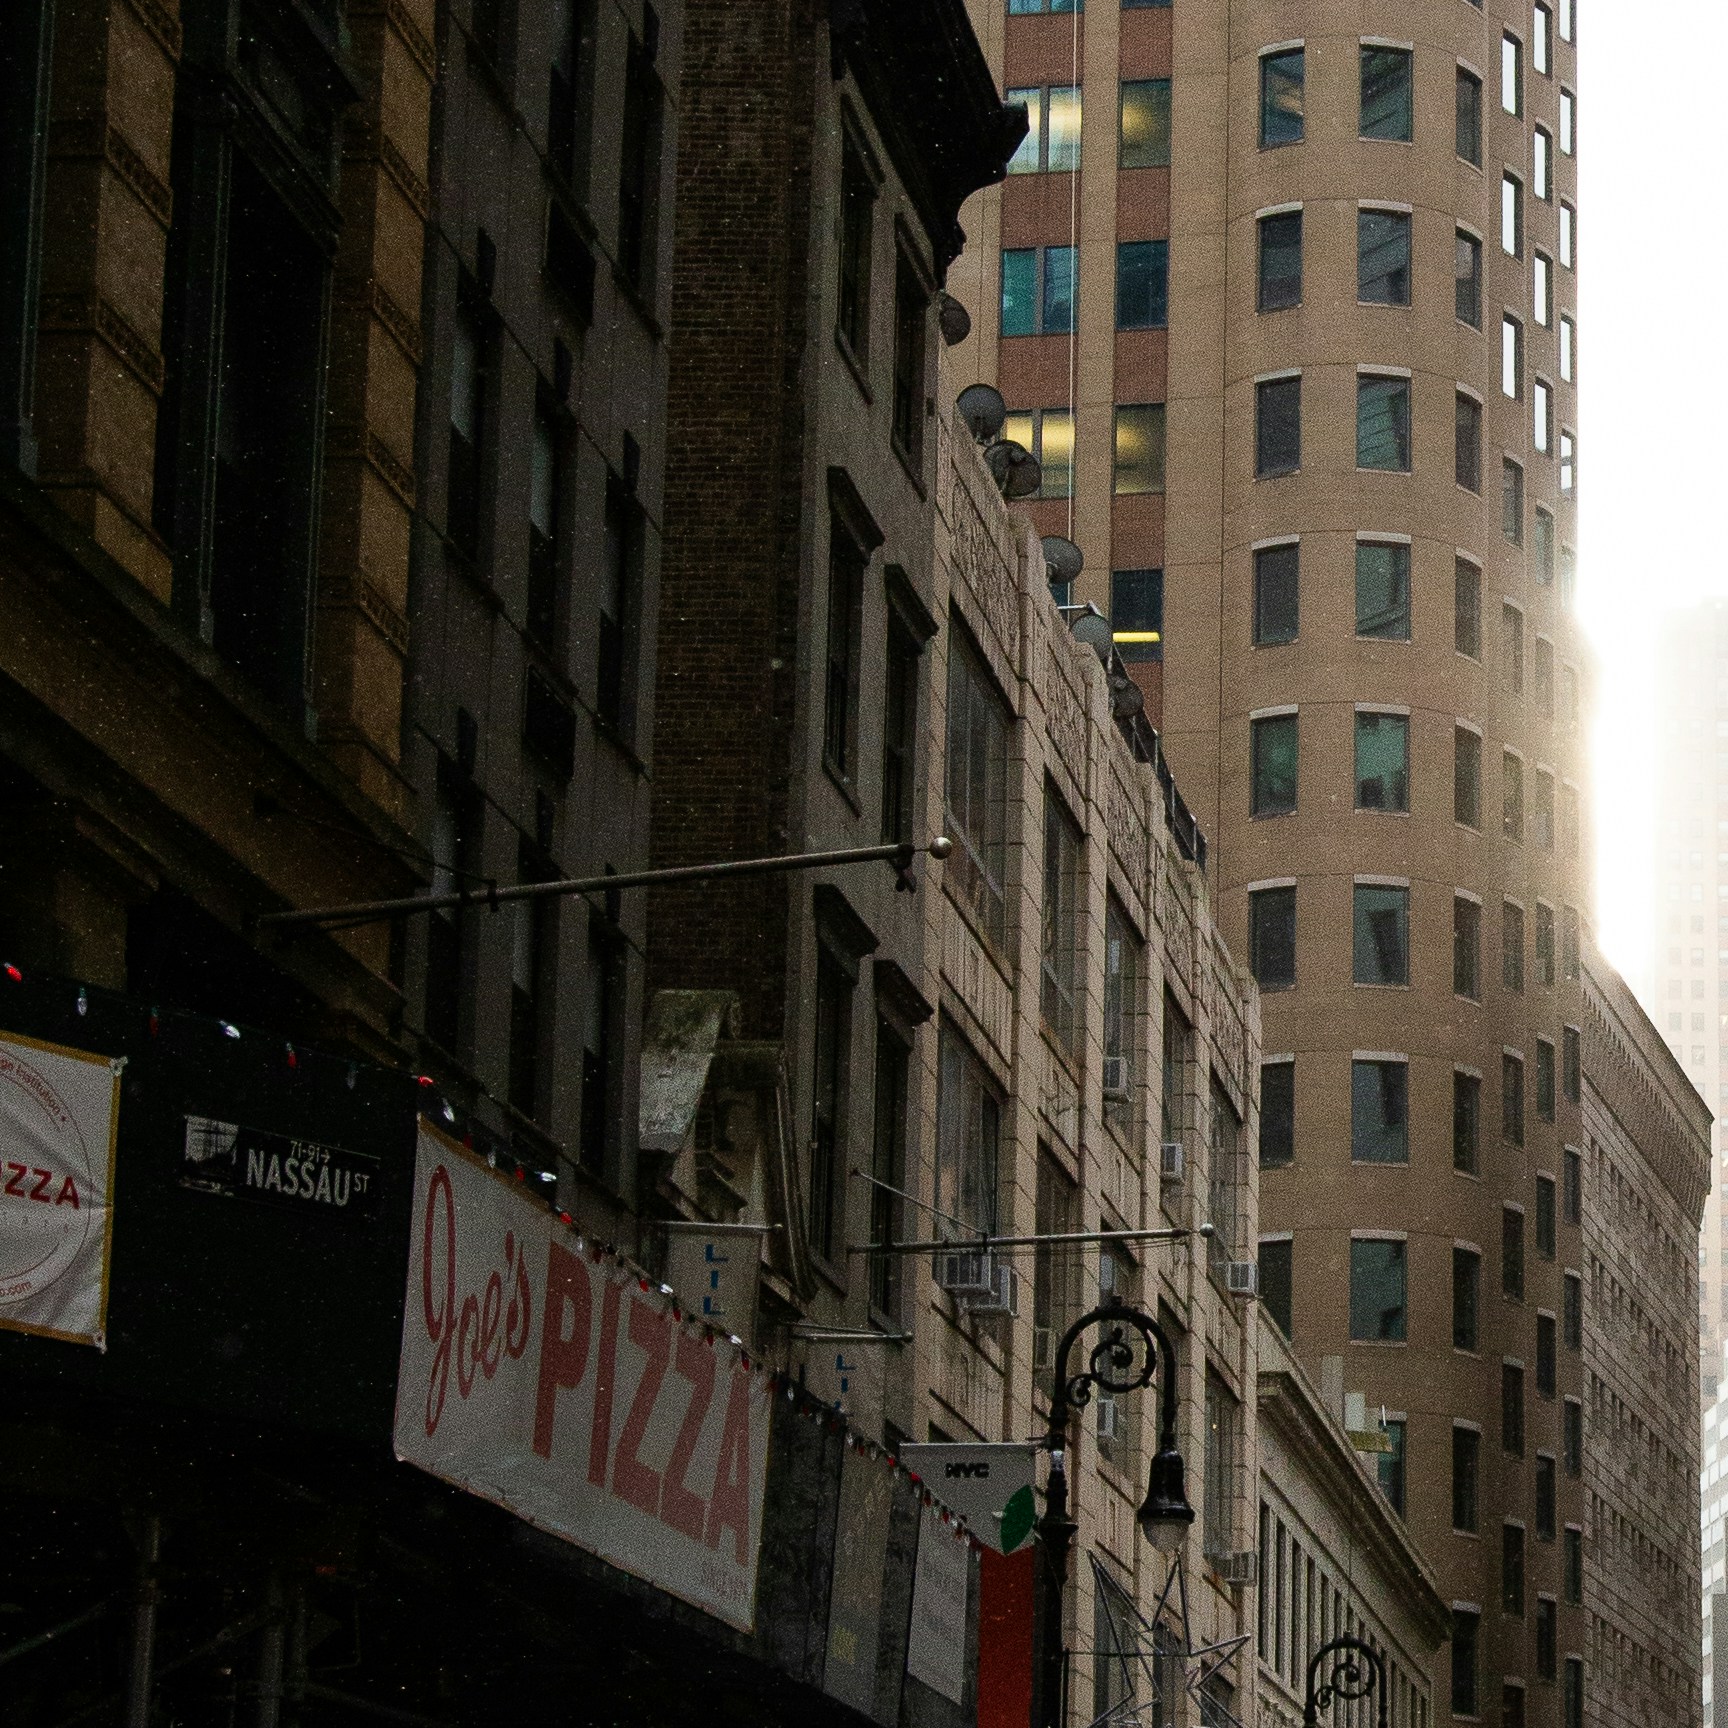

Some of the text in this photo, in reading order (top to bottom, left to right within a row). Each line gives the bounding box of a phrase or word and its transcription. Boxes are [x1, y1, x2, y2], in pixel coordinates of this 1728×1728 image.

[246, 1147, 370, 1207] NASSAU ST
[424, 1165, 752, 1568] Joe's PIZZA
[945, 1462, 989, 1478] NYC
